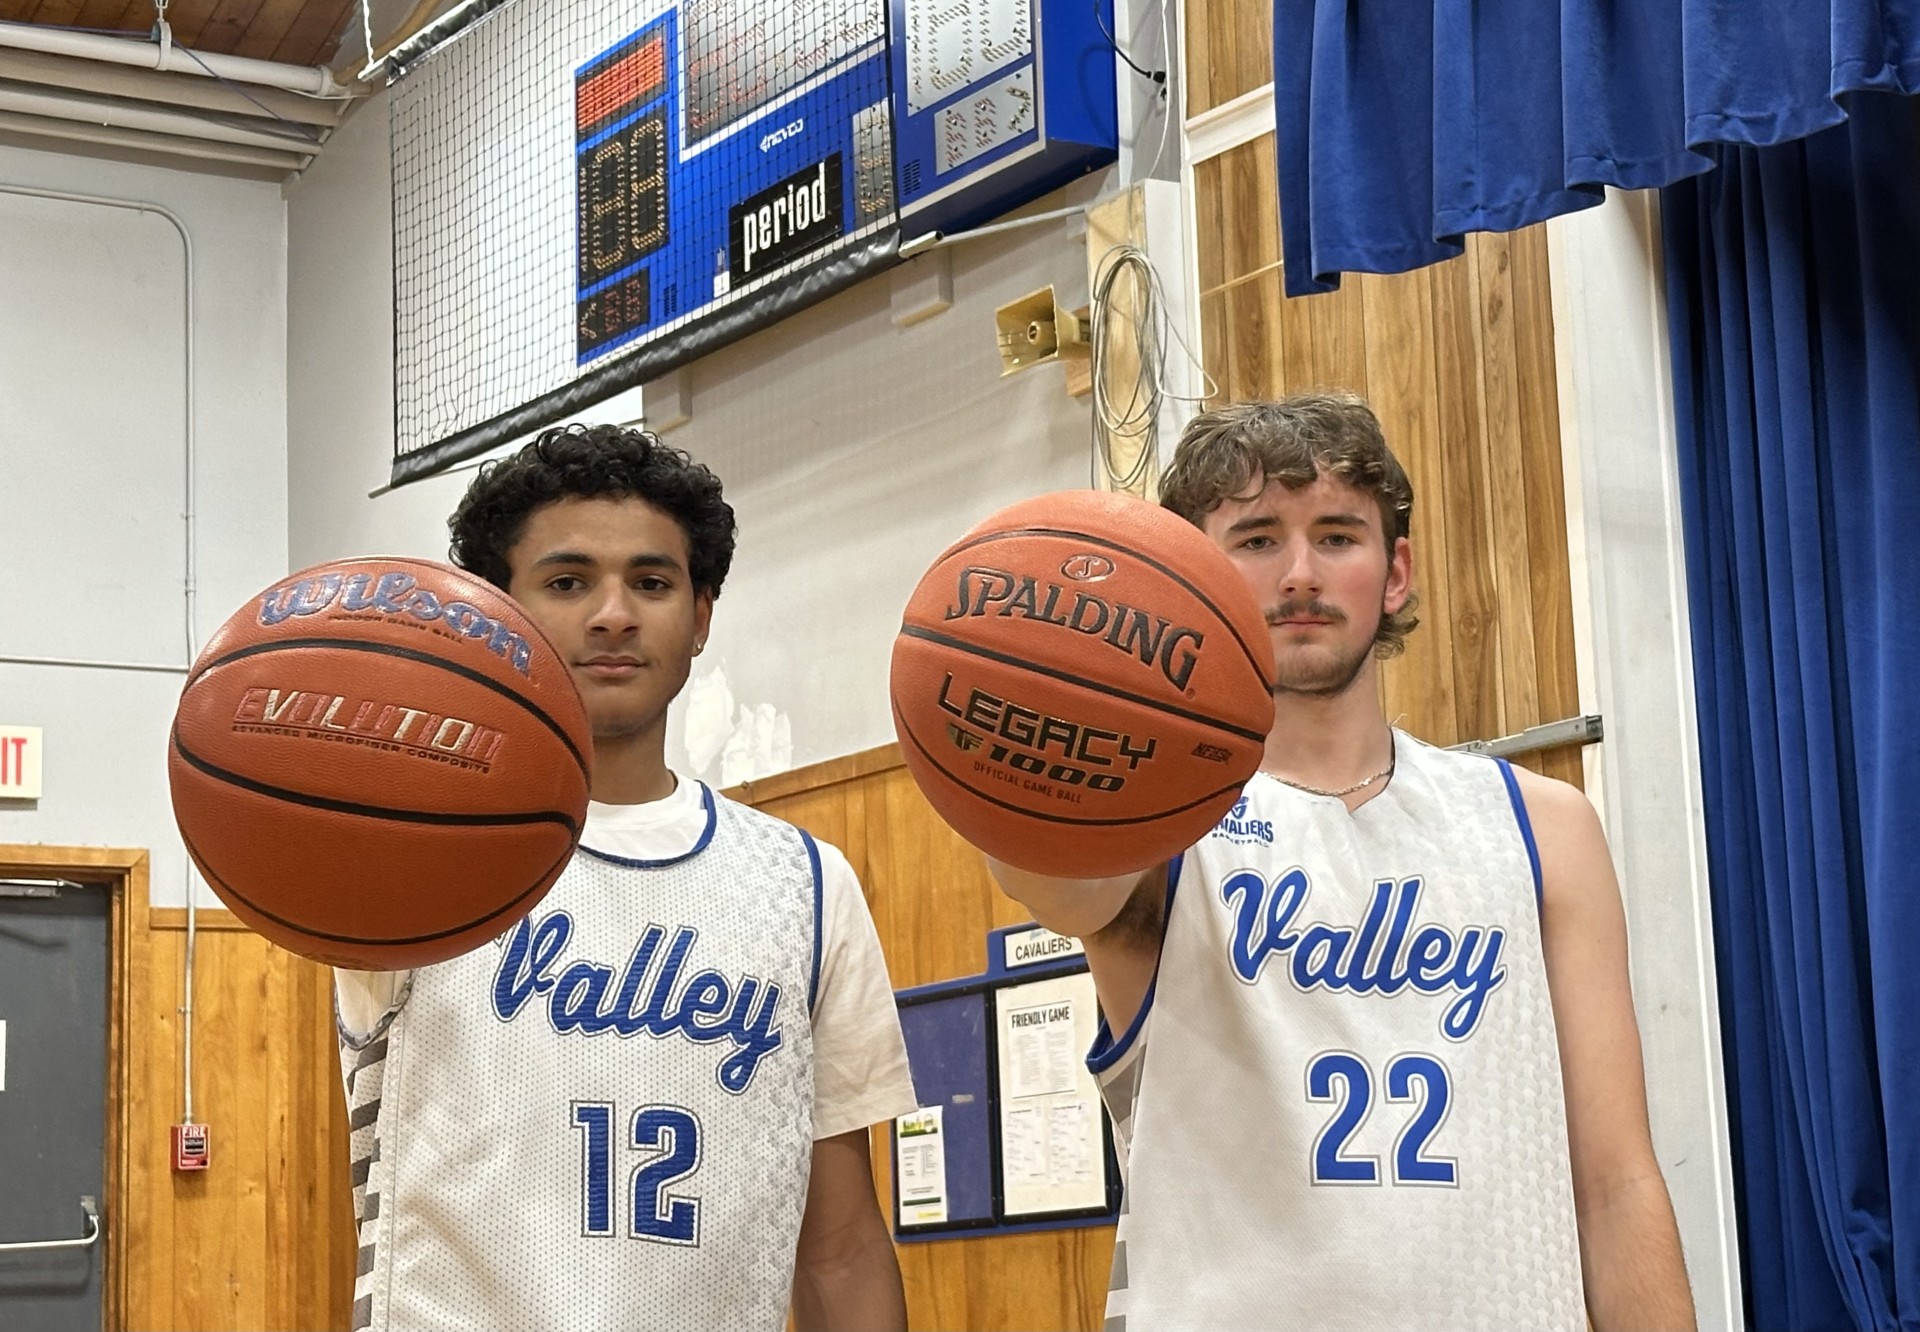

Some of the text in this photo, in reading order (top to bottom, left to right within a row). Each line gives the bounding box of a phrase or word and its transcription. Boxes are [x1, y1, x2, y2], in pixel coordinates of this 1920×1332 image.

[743, 160, 826, 272] period
[256, 571, 533, 680] Wilson
[387, 617, 427, 631] GAME
[432, 627, 464, 644] BALL
[945, 566, 1204, 692] SPALDING
[231, 725, 491, 774] ADVANCED MICROFIBER COMPOSITE
[233, 687, 503, 762] EVOLUTION
[937, 670, 1157, 771] LEGACY
[0, 736, 28, 786] IT
[974, 760, 1082, 804] OFFICIAL GAME BALL
[988, 743, 1126, 792] 1000
[1015, 936, 1073, 960] CAVALIERS
[1219, 864, 1508, 1044] Valley
[491, 909, 784, 1096] Valley
[1011, 1005, 1070, 1029] FRIENDLY GAME
[182, 1125, 206, 1138] FIRE
[1305, 1049, 1461, 1189] 22
[569, 1099, 703, 1248] 12
